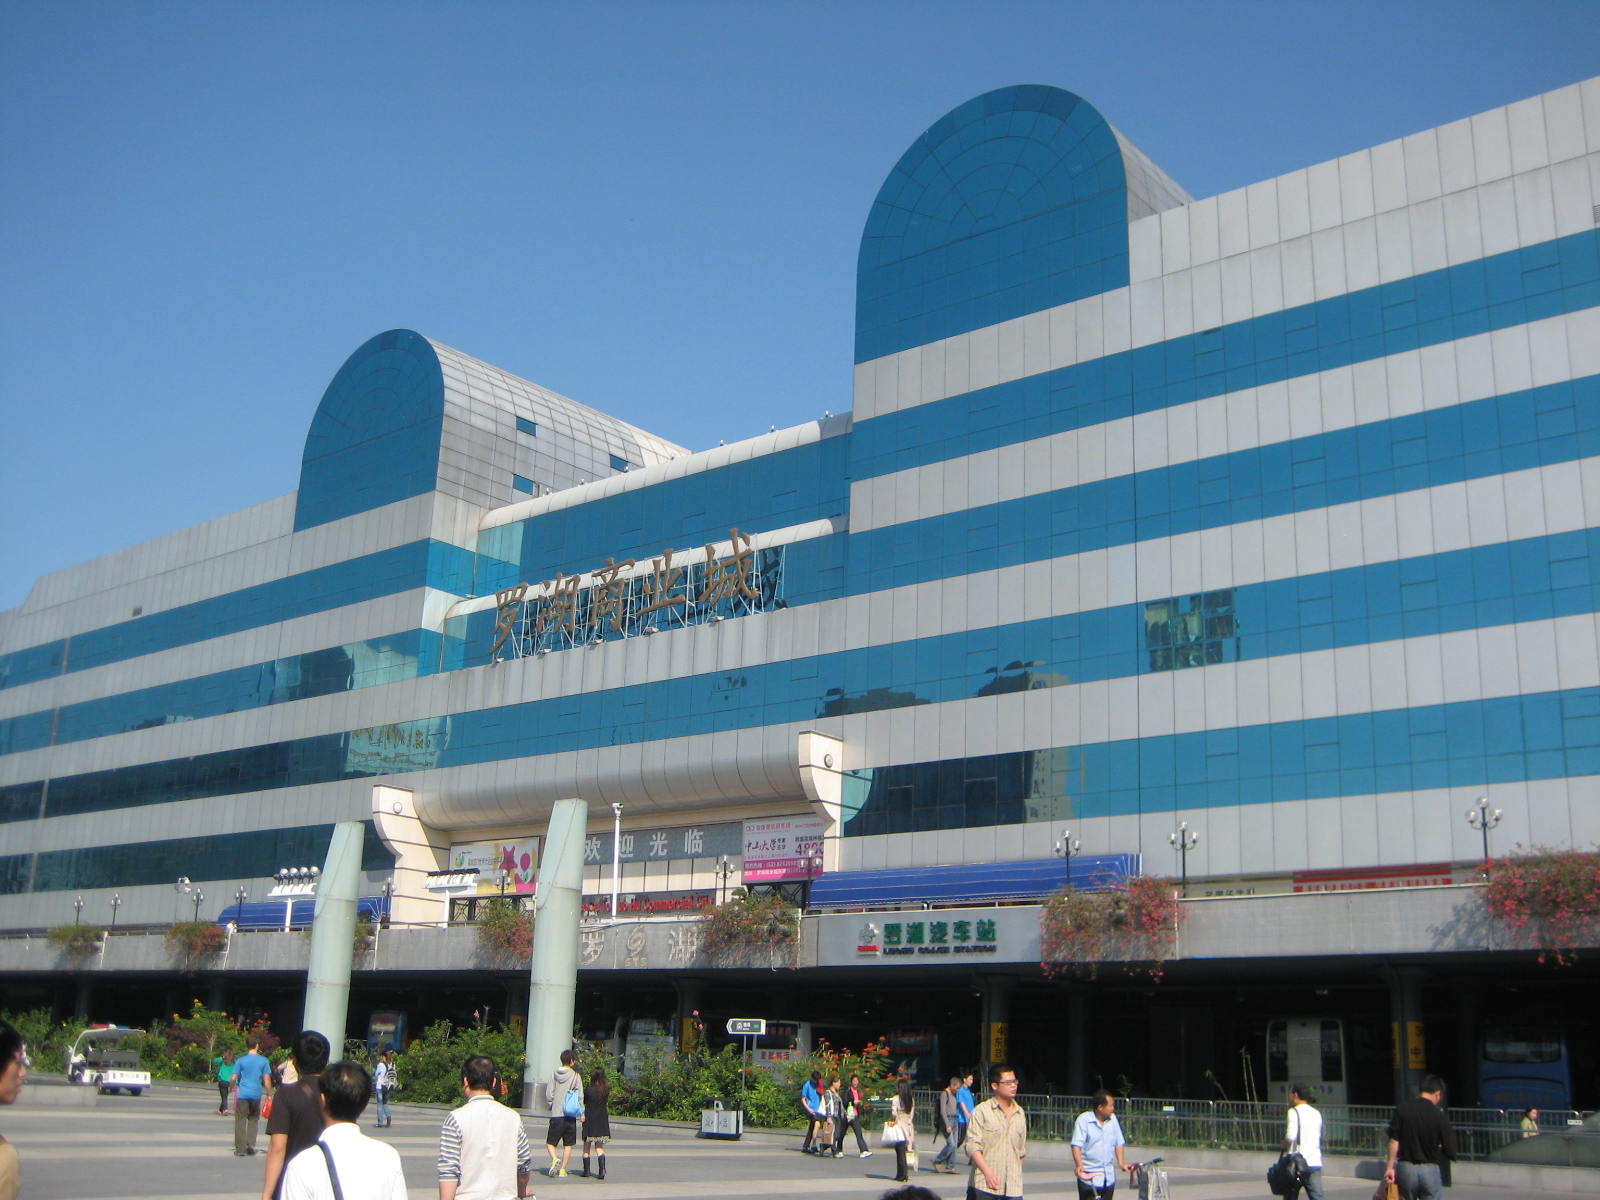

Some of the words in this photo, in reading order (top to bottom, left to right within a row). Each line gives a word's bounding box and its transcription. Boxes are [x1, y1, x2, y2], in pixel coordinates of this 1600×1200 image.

[489, 528, 758, 653] 罗湖商业城
[584, 828, 704, 861] 欢迎光临
[643, 897, 693, 911] Commercial
[884, 918, 997, 944] 罗湖汽车站
